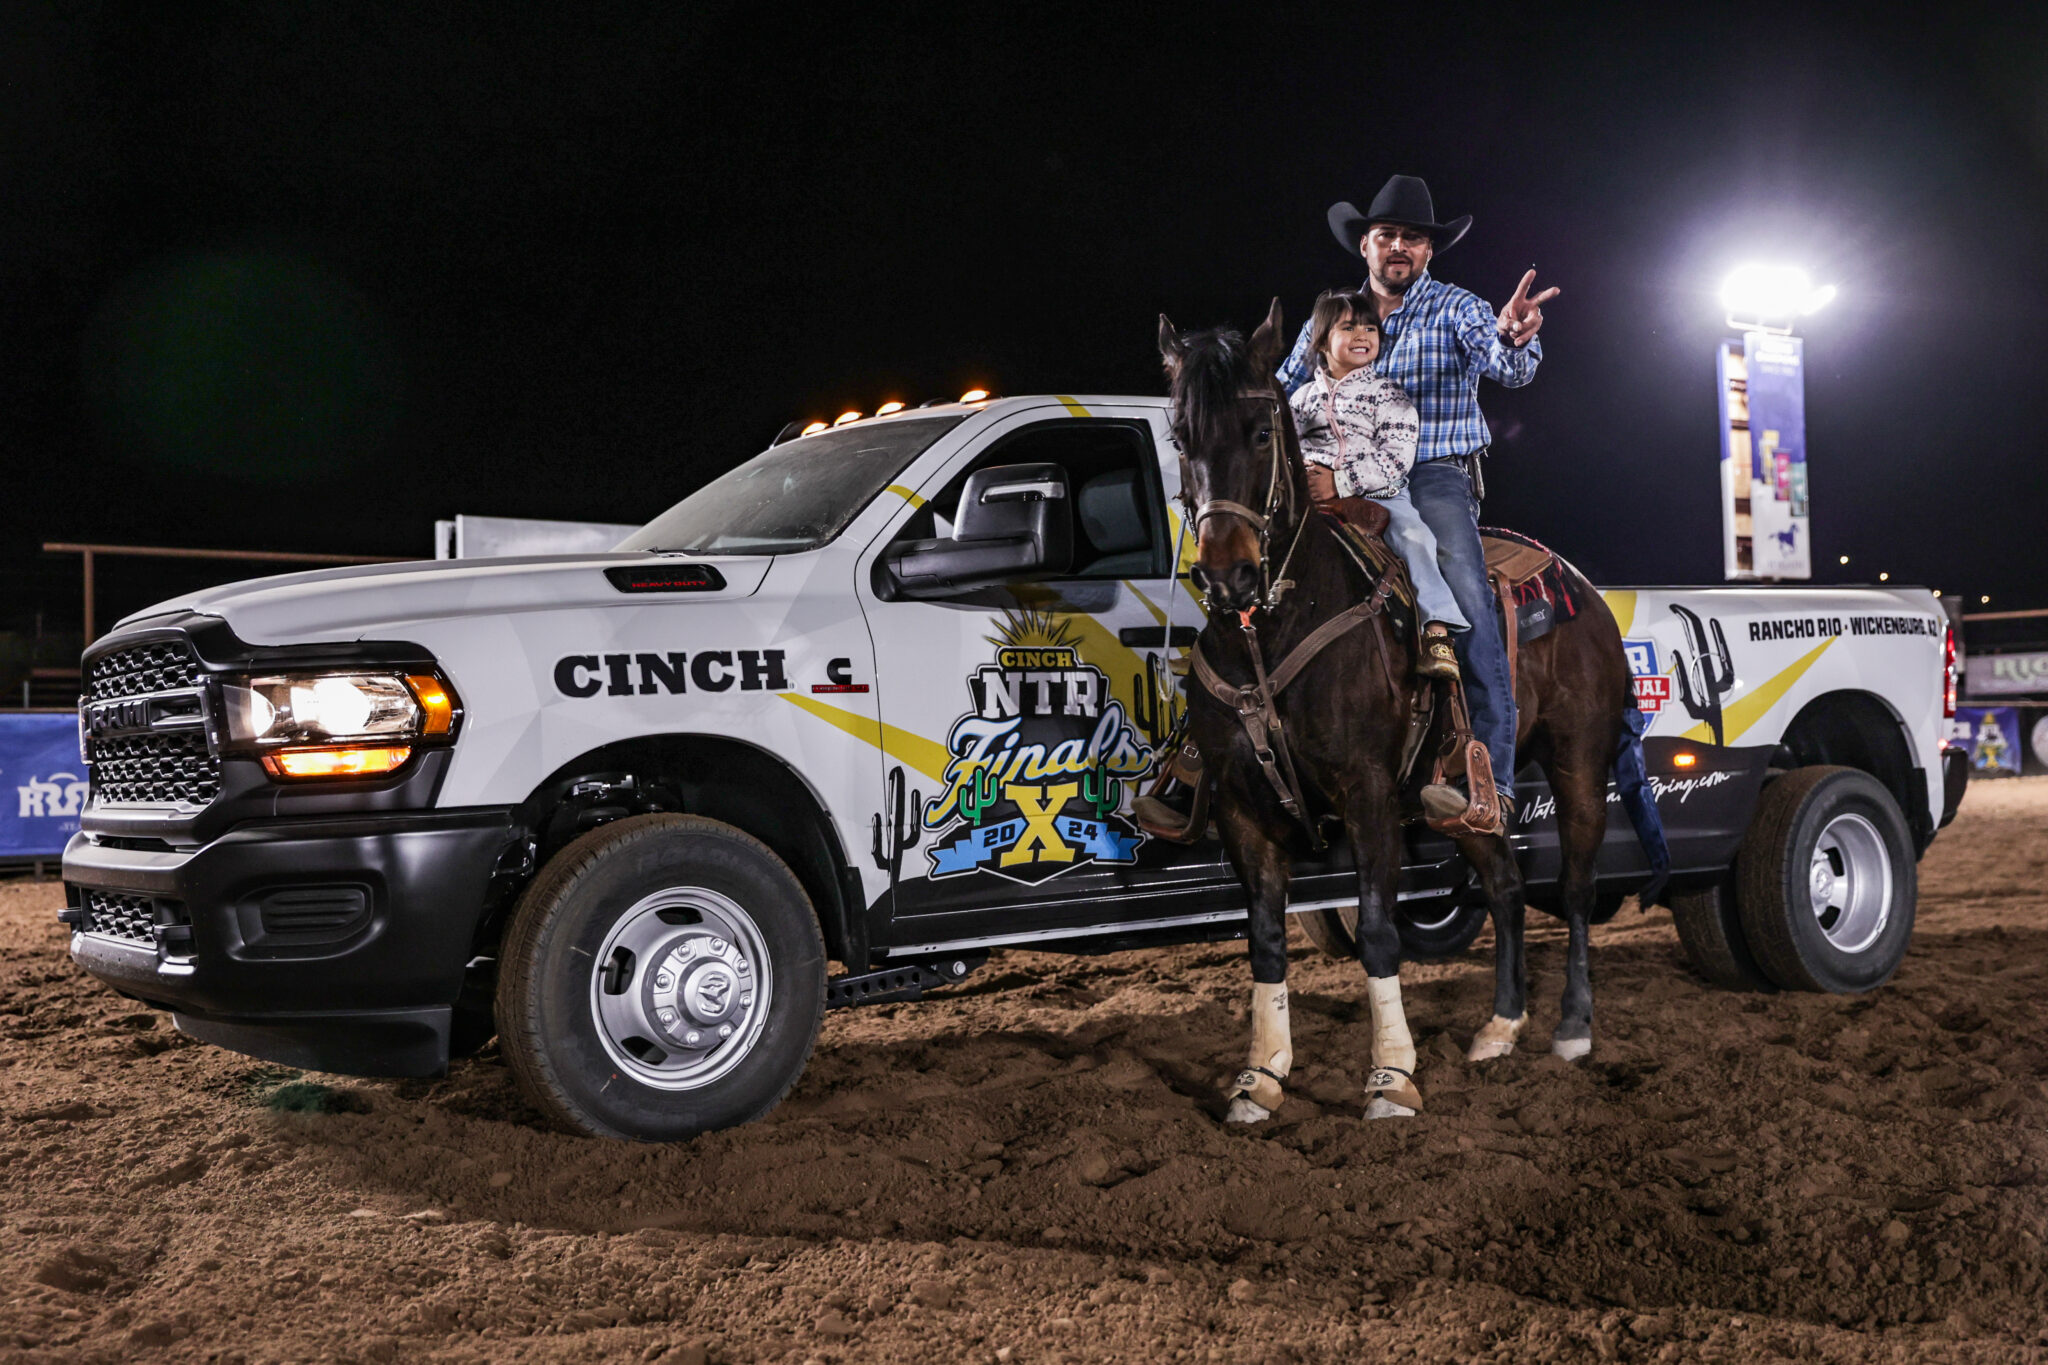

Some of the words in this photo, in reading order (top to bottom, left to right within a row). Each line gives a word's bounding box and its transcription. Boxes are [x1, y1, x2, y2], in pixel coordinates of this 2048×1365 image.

[1749, 618, 1815, 641] RANCHO
[1818, 617, 1842, 637] RIO
[553, 649, 788, 698] CINCH
[1000, 651, 1074, 668] CINCH
[982, 671, 1099, 719] NTR
[91, 700, 144, 729] RAM
[924, 704, 1153, 826] Finals
